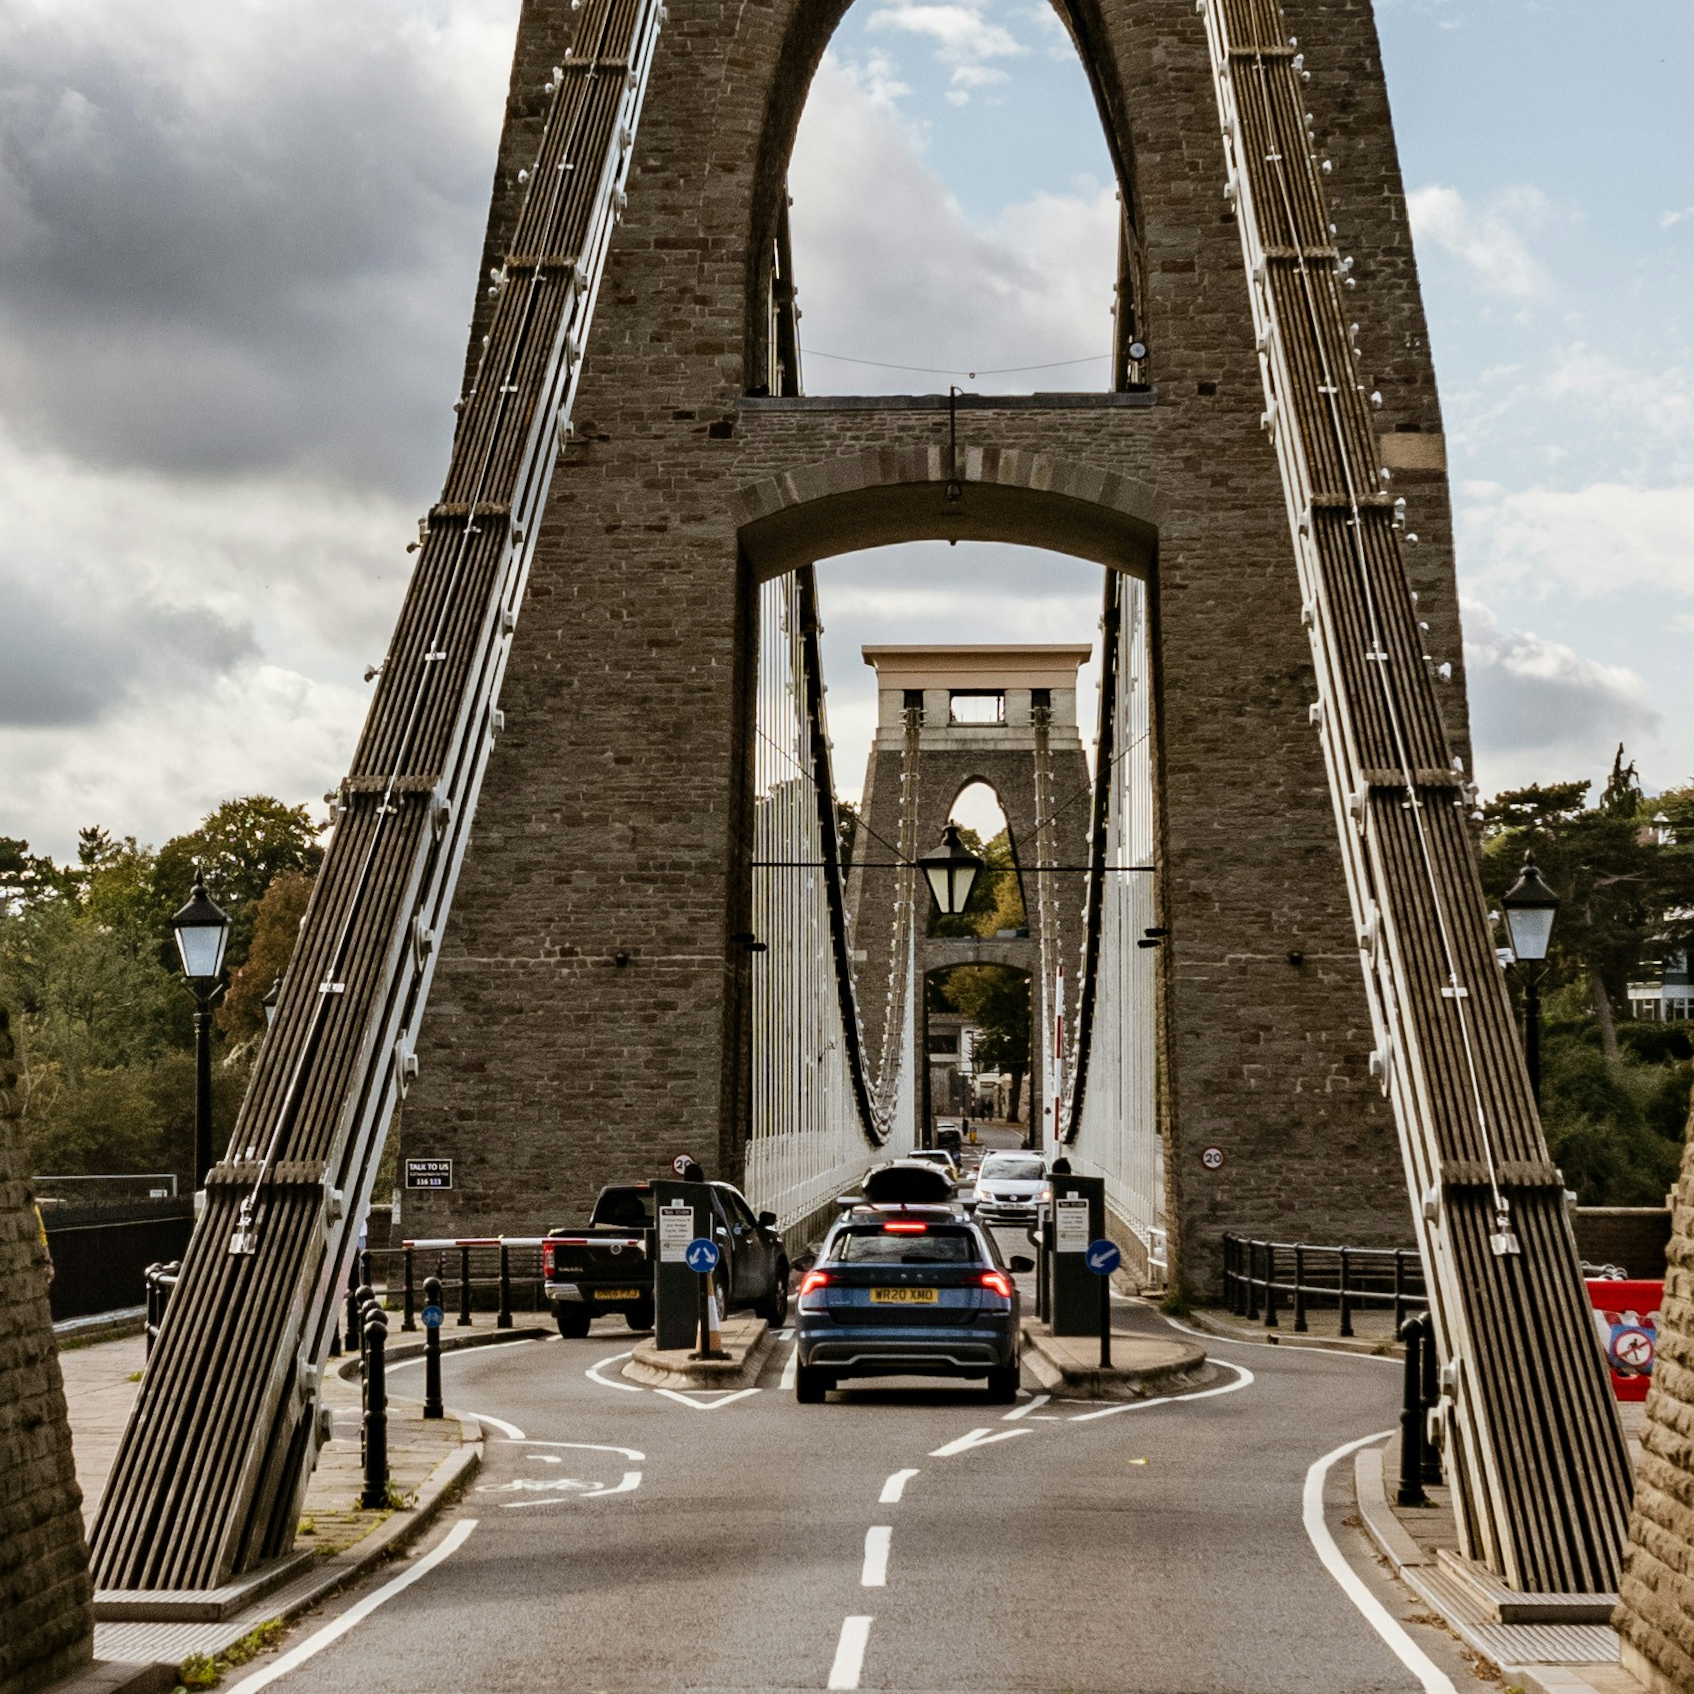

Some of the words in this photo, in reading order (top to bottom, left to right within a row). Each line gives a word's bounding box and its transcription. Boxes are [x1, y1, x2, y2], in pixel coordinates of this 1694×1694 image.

[1205, 1153, 1221, 1163] 20
[409, 1163, 426, 1171] TALK
[427, 1163, 438, 1171] TO
[438, 1163, 449, 1171] US
[875, 1289, 906, 1300] WR20
